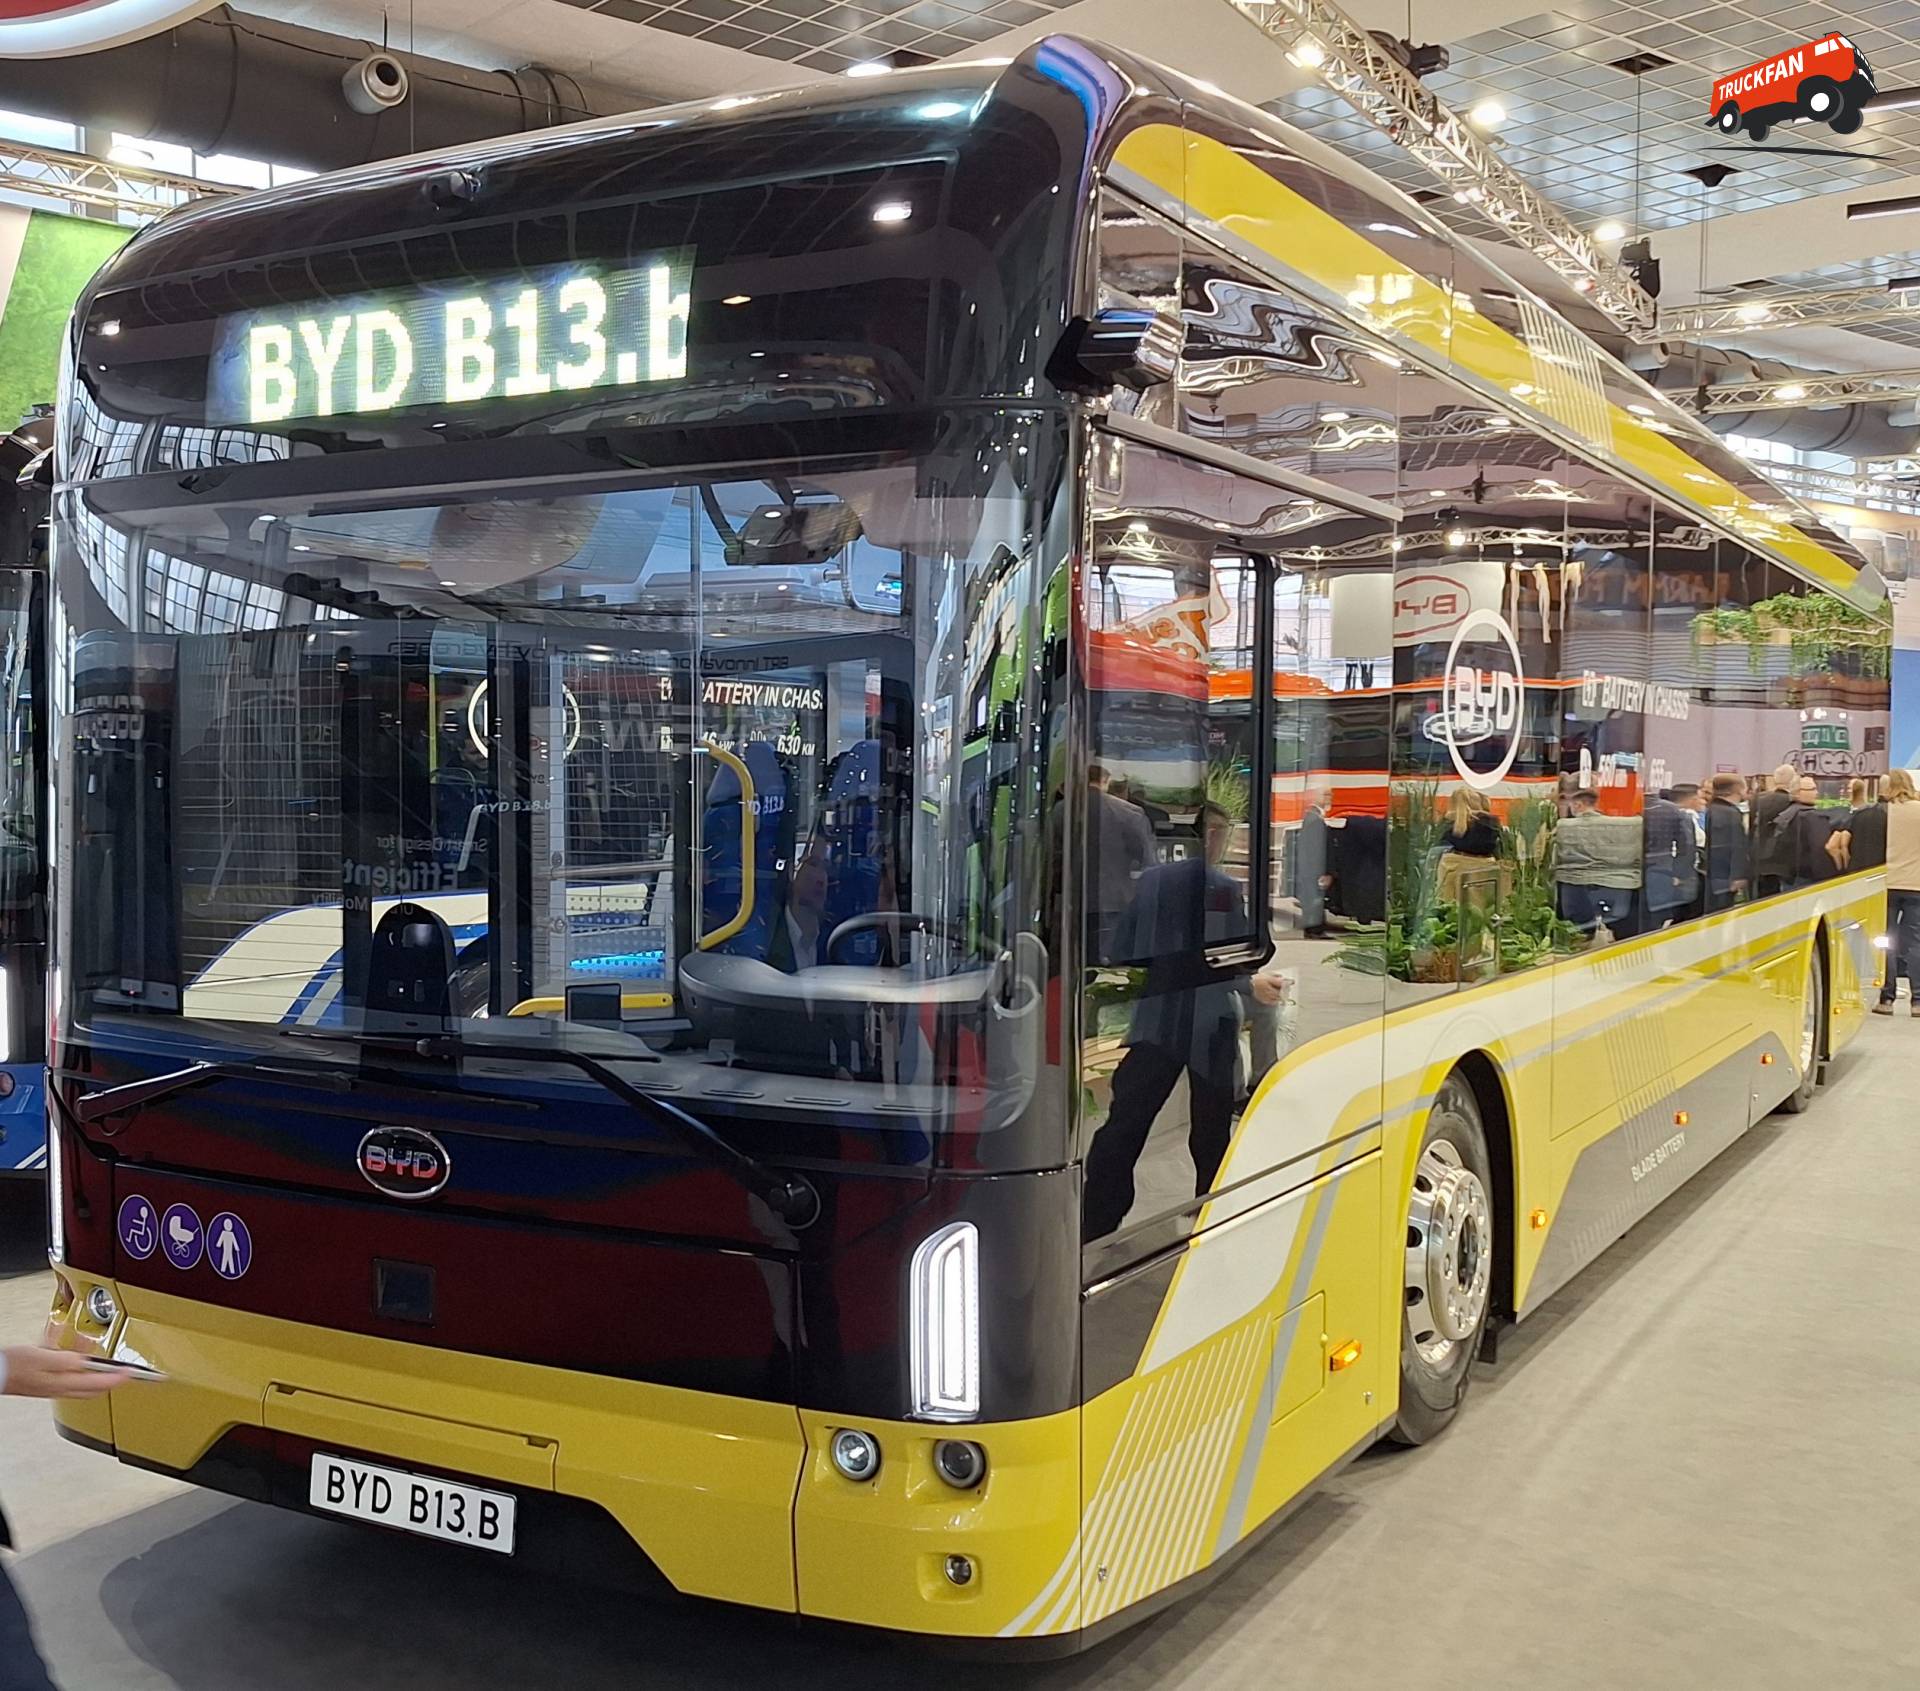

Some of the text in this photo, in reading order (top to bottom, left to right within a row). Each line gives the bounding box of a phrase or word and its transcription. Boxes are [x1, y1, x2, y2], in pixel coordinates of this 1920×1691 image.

[249, 264, 690, 424] BYD B13.b
[764, 686, 779, 706] IN
[1454, 665, 1517, 733] BYD
[1601, 675, 1645, 713] BATTERY
[777, 734, 801, 755] 630
[366, 1144, 438, 1178] BYD
[1631, 1131, 1686, 1182] BLADE BATTERY
[327, 1464, 500, 1541] BYD B13.B
